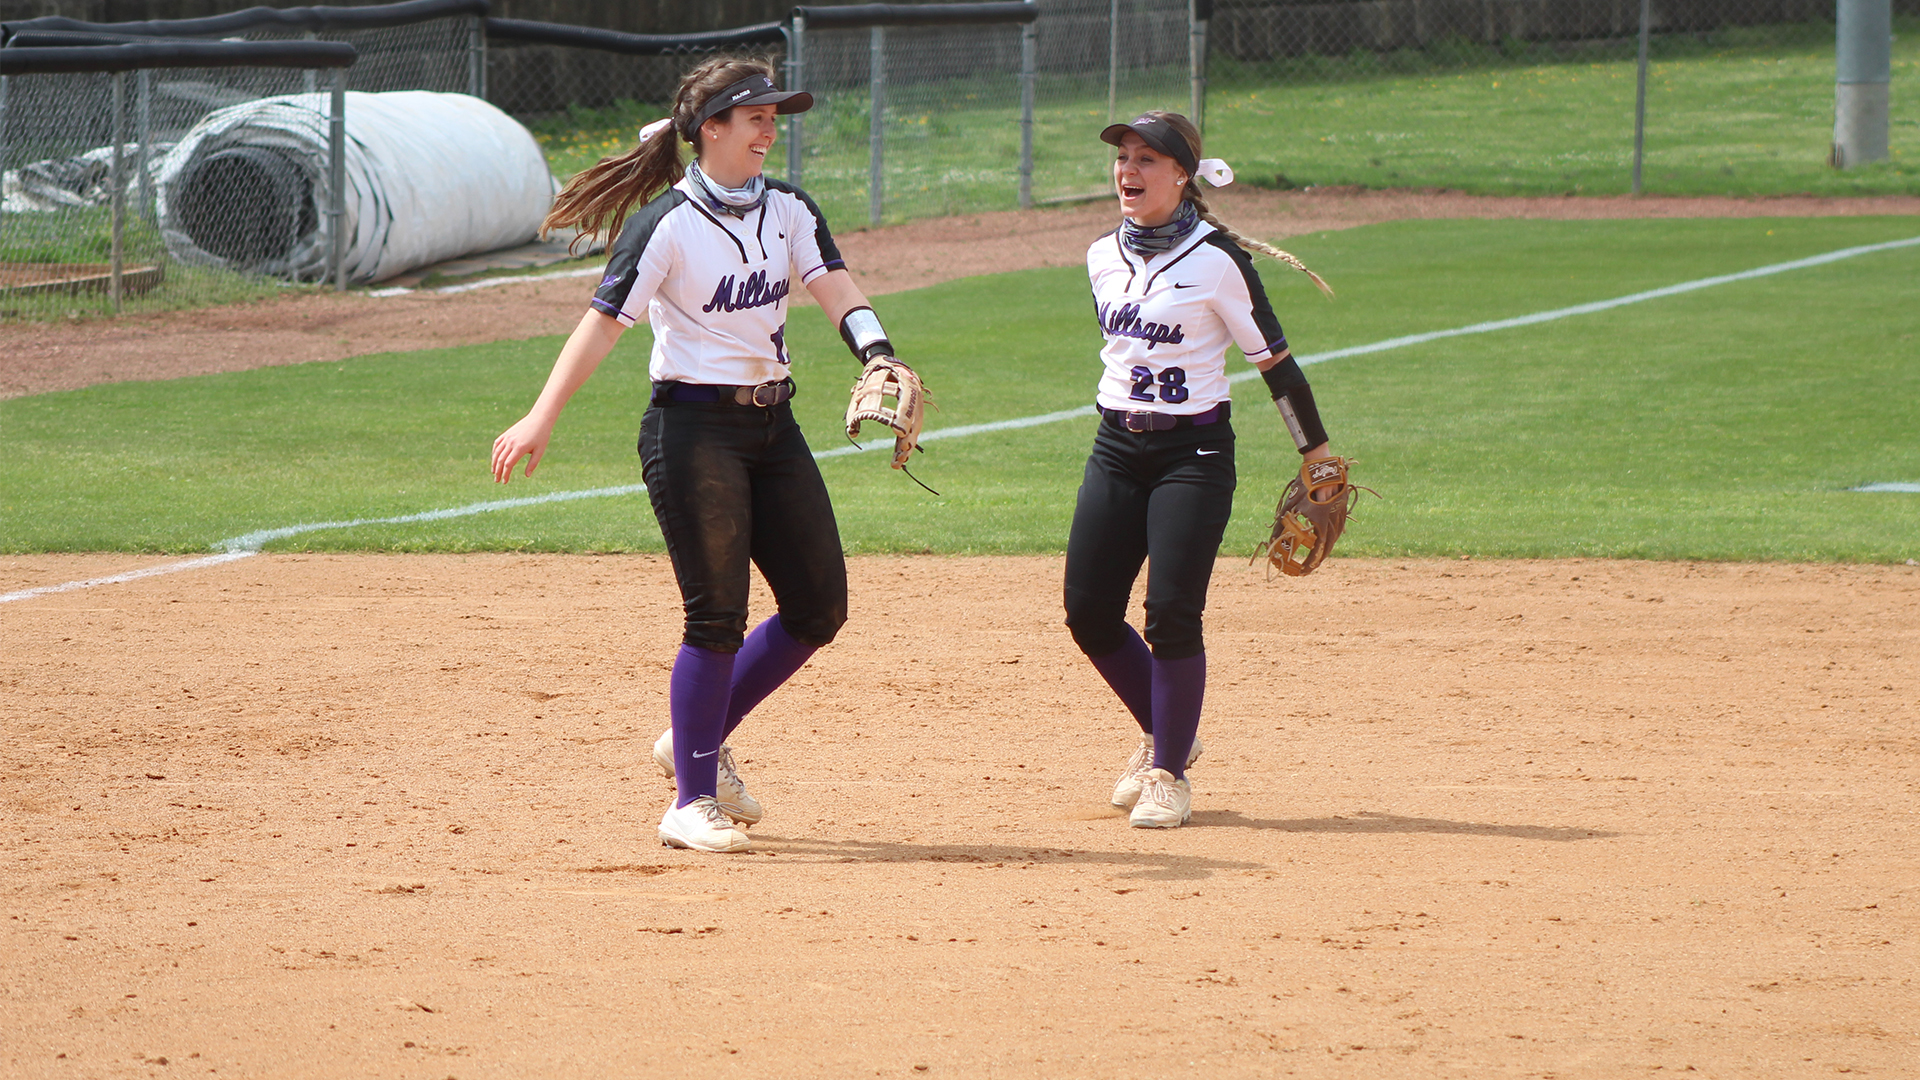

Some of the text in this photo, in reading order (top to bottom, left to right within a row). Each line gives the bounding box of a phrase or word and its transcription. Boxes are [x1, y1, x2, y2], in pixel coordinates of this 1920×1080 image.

[702, 269, 790, 313] Millsap
[770, 321, 792, 365] 1
[1128, 365, 1189, 404] 28
